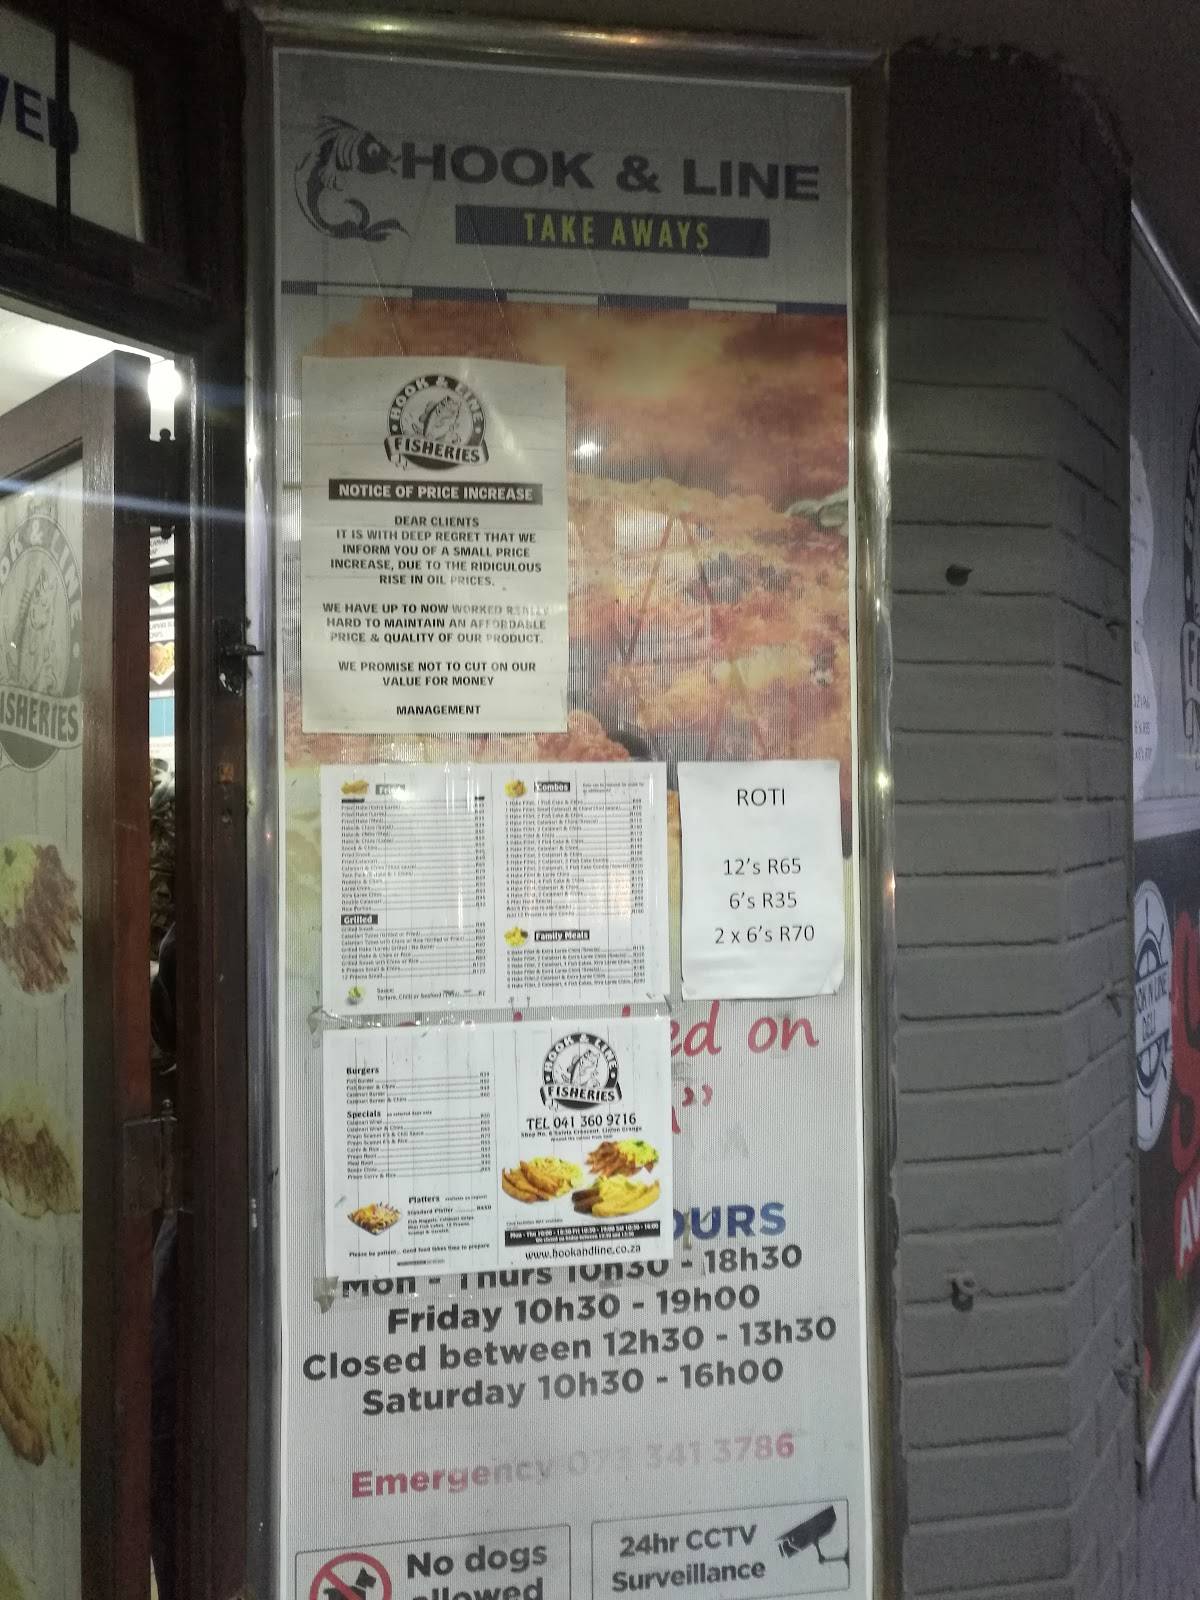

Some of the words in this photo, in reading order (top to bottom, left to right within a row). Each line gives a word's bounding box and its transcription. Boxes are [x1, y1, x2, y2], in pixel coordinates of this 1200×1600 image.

[400, 142, 595, 190] HOOK
[616, 155, 661, 194] &
[683, 157, 820, 201] LINE
[524, 212, 595, 245] TAKE
[611, 219, 710, 250] AWAYS
[394, 437, 481, 463] FISHERIES
[339, 483, 391, 497] NOTICE
[396, 485, 413, 498] OF
[418, 486, 459, 499] PRICE
[463, 487, 533, 501] INCREASE
[394, 516, 427, 527] DEAR
[431, 517, 479, 528] CLIENTS
[337, 529, 347, 539] IT
[352, 530, 363, 540] IS
[367, 530, 398, 541] WITH
[401, 531, 431, 541] DEEP
[435, 532, 480, 543] REGRET
[485, 533, 515, 543] THAT
[518, 534, 536, 544] WE
[343, 544, 390, 555] INFORM
[394, 545, 419, 556] YOU
[422, 546, 437, 556] OF
[441, 546, 450, 556] A
[453, 546, 492, 558] SMALL
[495, 547, 530, 558] PRICE
[330, 559, 394, 571] INCREASE,
[398, 560, 422, 570] DUE
[426, 560, 441, 571] TO
[446, 561, 467, 572] THE
[470, 562, 542, 573] RIDICULOUS
[379, 575, 407, 585] RISE
[411, 575, 423, 585] IN
[427, 575, 446, 585] OIL
[450, 576, 495, 587] PRICES.
[322, 603, 341, 613] WE
[345, 603, 378, 614] HAVE
[382, 603, 398, 614] UP
[402, 603, 417, 614] TO
[421, 603, 449, 614] NOW
[452, 604, 502, 615] WORKED
[326, 618, 361, 628] HARD
[365, 618, 381, 628] TO
[384, 618, 445, 628] MAINTAIN
[449, 618, 466, 629] AN
[470, 619, 546, 630] AFFORDABLE
[330, 632, 366, 643] PRICE
[370, 633, 380, 642] &
[384, 632, 435, 643] QUALITY
[438, 633, 453, 643] OF
[457, 633, 482, 643] OUR
[486, 634, 543, 644] PRODUCT.
[338, 661, 356, 671] WE
[361, 662, 414, 672] PROMISE
[418, 662, 441, 671] NOT
[446, 662, 461, 671] TO
[464, 662, 488, 672] CUT
[491, 662, 508, 672] ON
[512, 662, 536, 672] OUR
[383, 676, 421, 686] VALUE
[425, 676, 448, 686] FOR
[452, 676, 495, 686] MONEY
[0, 693, 79, 742] ISHERIES
[396, 705, 481, 715] MANAGEMENT
[737, 788, 785, 806] ROTI
[723, 857, 761, 876] 12's
[768, 857, 801, 875] R65
[729, 892, 755, 909] 6's
[763, 891, 797, 908] R35
[343, 915, 373, 924] Grilled
[535, 932, 562, 942] Family
[564, 931, 589, 941] Meals
[715, 928, 724, 944] 2
[731, 931, 740, 943] x
[747, 925, 773, 943] 6's
[780, 925, 815, 942] R70
[748, 1015, 819, 1053] on
[346, 1067, 379, 1076] Burgers
[547, 1086, 616, 1102] FISHERIES
[347, 1110, 381, 1119] Specials
[526, 1117, 550, 1130] TEL
[553, 1116, 575, 1128] 041
[580, 1115, 603, 1127] 360
[606, 1113, 637, 1126] 9716
[408, 1195, 440, 1204] Platters
[526, 1244, 641, 1261] www.hookandline.co.za
[342, 1276, 417, 1298] Mon
[704, 1244, 802, 1274] 18h30
[388, 1304, 501, 1334] Friday
[515, 1294, 620, 1325] 10h30
[656, 1284, 760, 1315] 19h00
[303, 1345, 426, 1381] Closed
[439, 1338, 591, 1370] between
[603, 1326, 704, 1356] 12h30
[739, 1316, 836, 1347] 13h30
[362, 1379, 526, 1415] Saturday
[538, 1367, 644, 1401] 10h30
[680, 1357, 783, 1389] 16h00
[351, 1459, 553, 1498] Emergency
[713, 1432, 796, 1464] 3786
[619, 1533, 679, 1559] 24hr
[686, 1525, 758, 1551] CCTV
[407, 1552, 454, 1579] No
[465, 1545, 548, 1573] dogs
[612, 1561, 766, 1593] Surveillance
[412, 1577, 544, 1600] llowed
